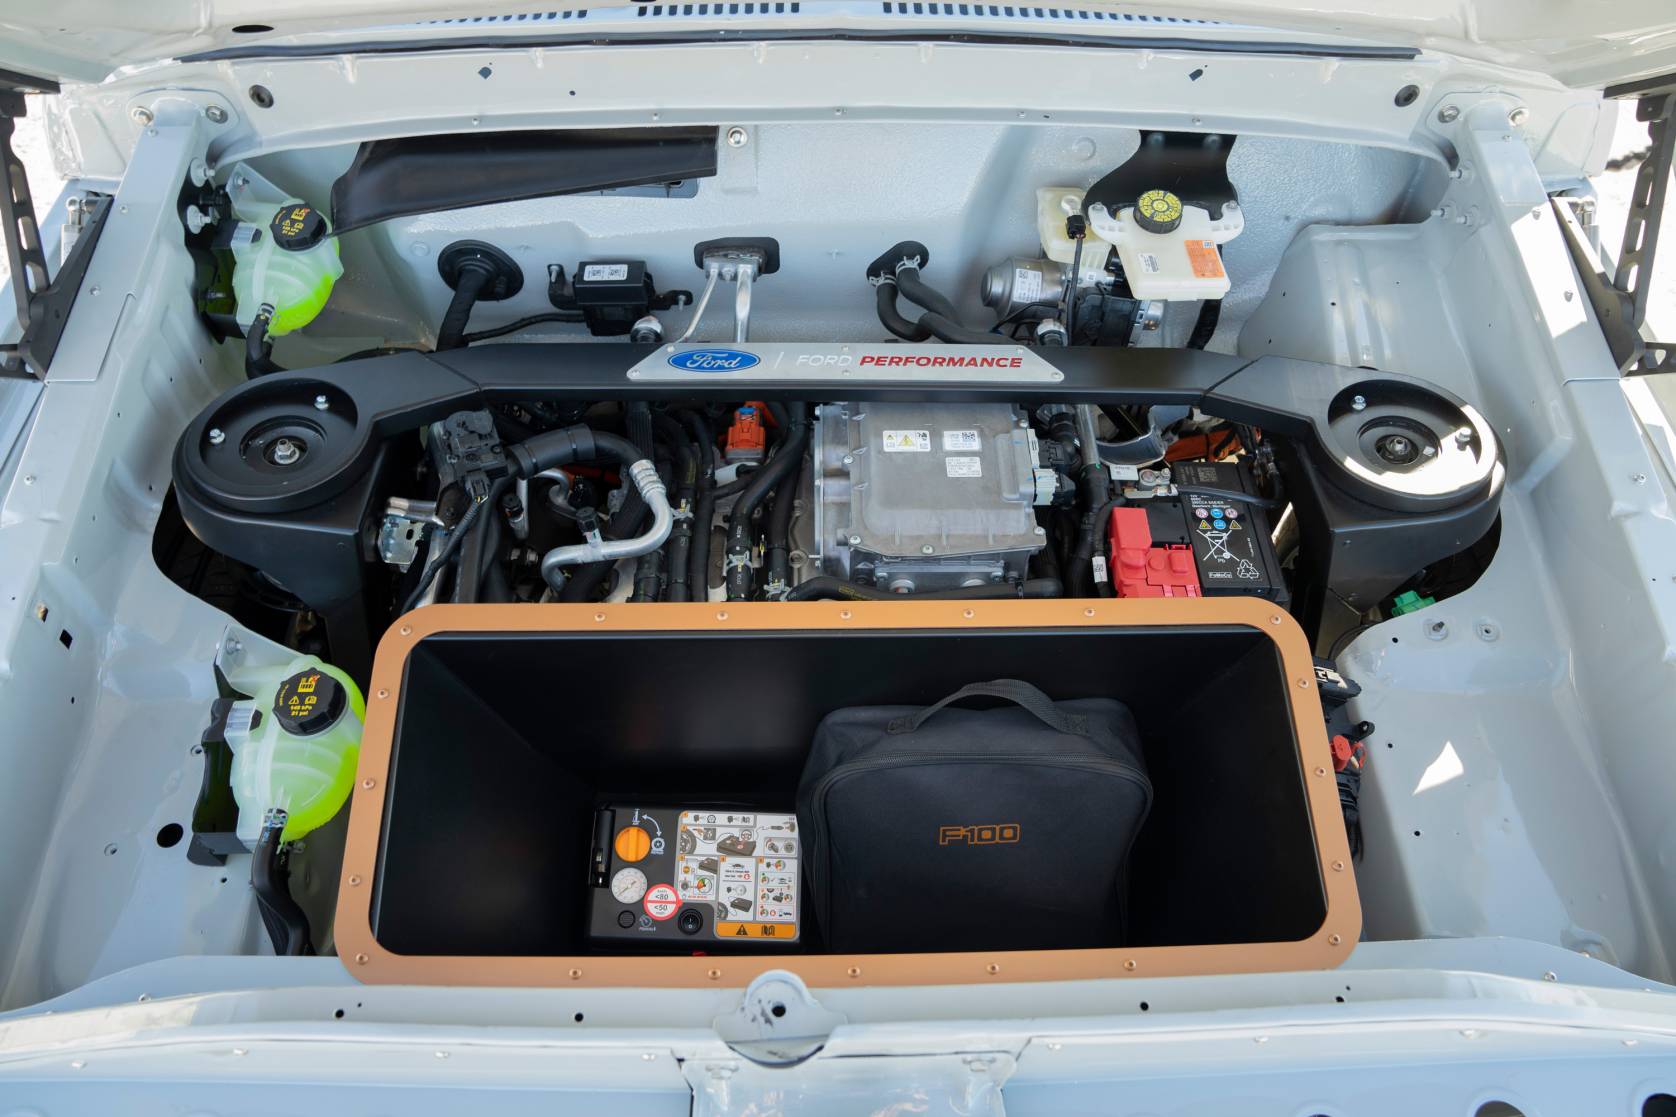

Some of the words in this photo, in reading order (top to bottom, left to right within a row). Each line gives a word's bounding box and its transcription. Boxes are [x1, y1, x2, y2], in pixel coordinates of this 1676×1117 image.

[686, 352, 741, 368] Ford
[796, 355, 853, 367] FORD
[859, 355, 1023, 368] PERFORMANCE
[940, 823, 1020, 846] F100
